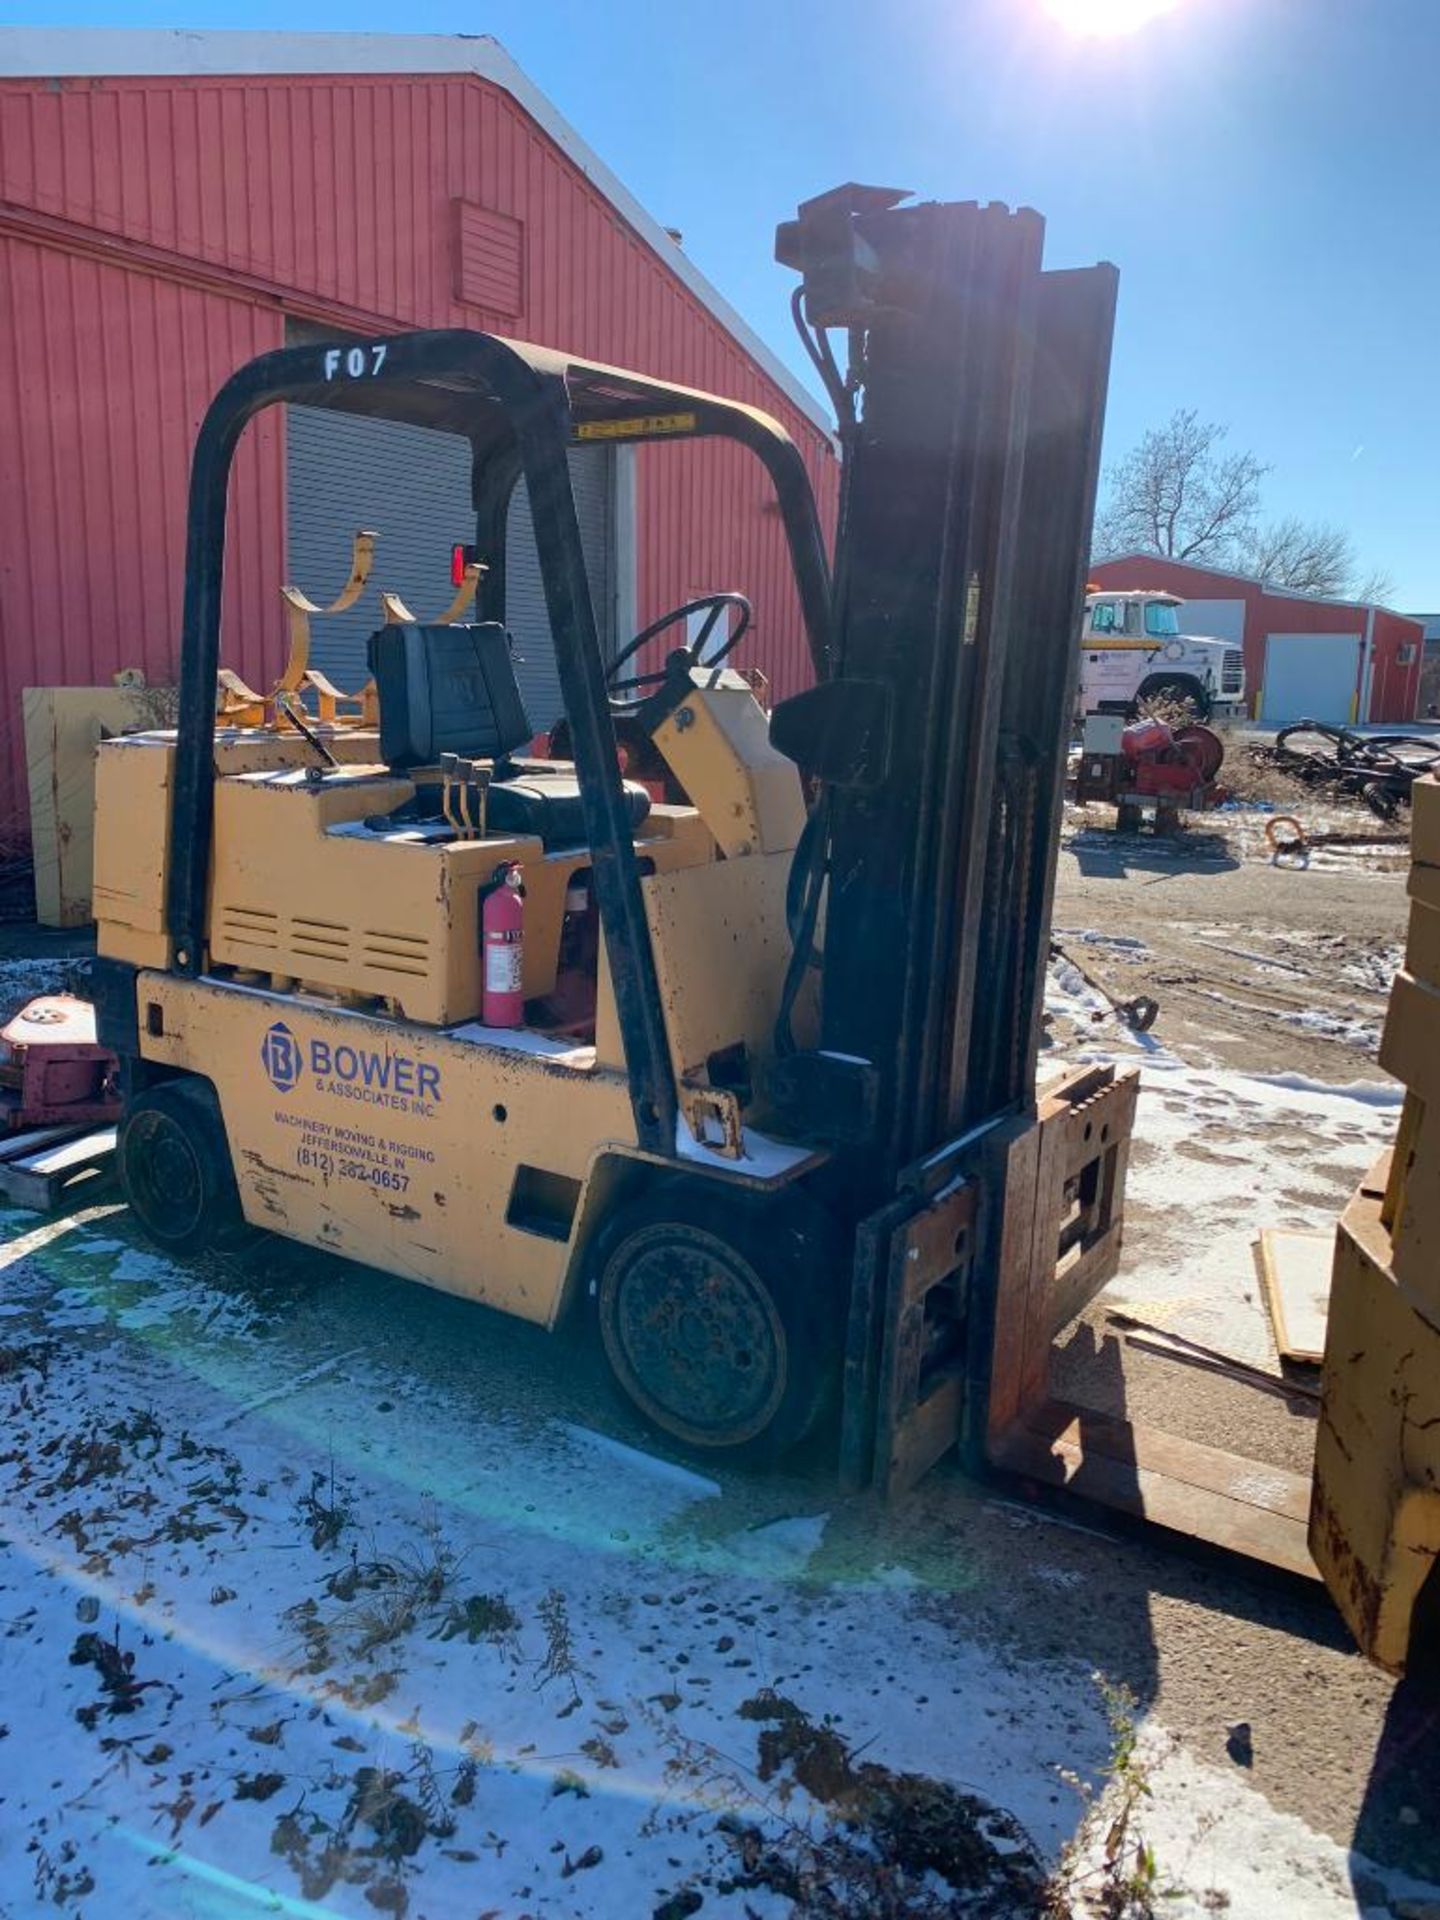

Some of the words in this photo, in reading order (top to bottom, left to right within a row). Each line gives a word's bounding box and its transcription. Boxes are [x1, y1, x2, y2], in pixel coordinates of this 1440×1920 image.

[325, 345, 387, 381] F07
[311, 1040, 441, 1101] BOWER
[316, 1079, 324, 1091] &
[327, 1080, 408, 1112] ASSOCIATES
[274, 1111, 332, 1134] MACHINERY
[334, 1126, 376, 1148] MOVING
[378, 1138, 386, 1149] &
[388, 1141, 435, 1163] RIGGING
[296, 1147, 334, 1177] (812)
[394, 1157, 406, 1170] IN
